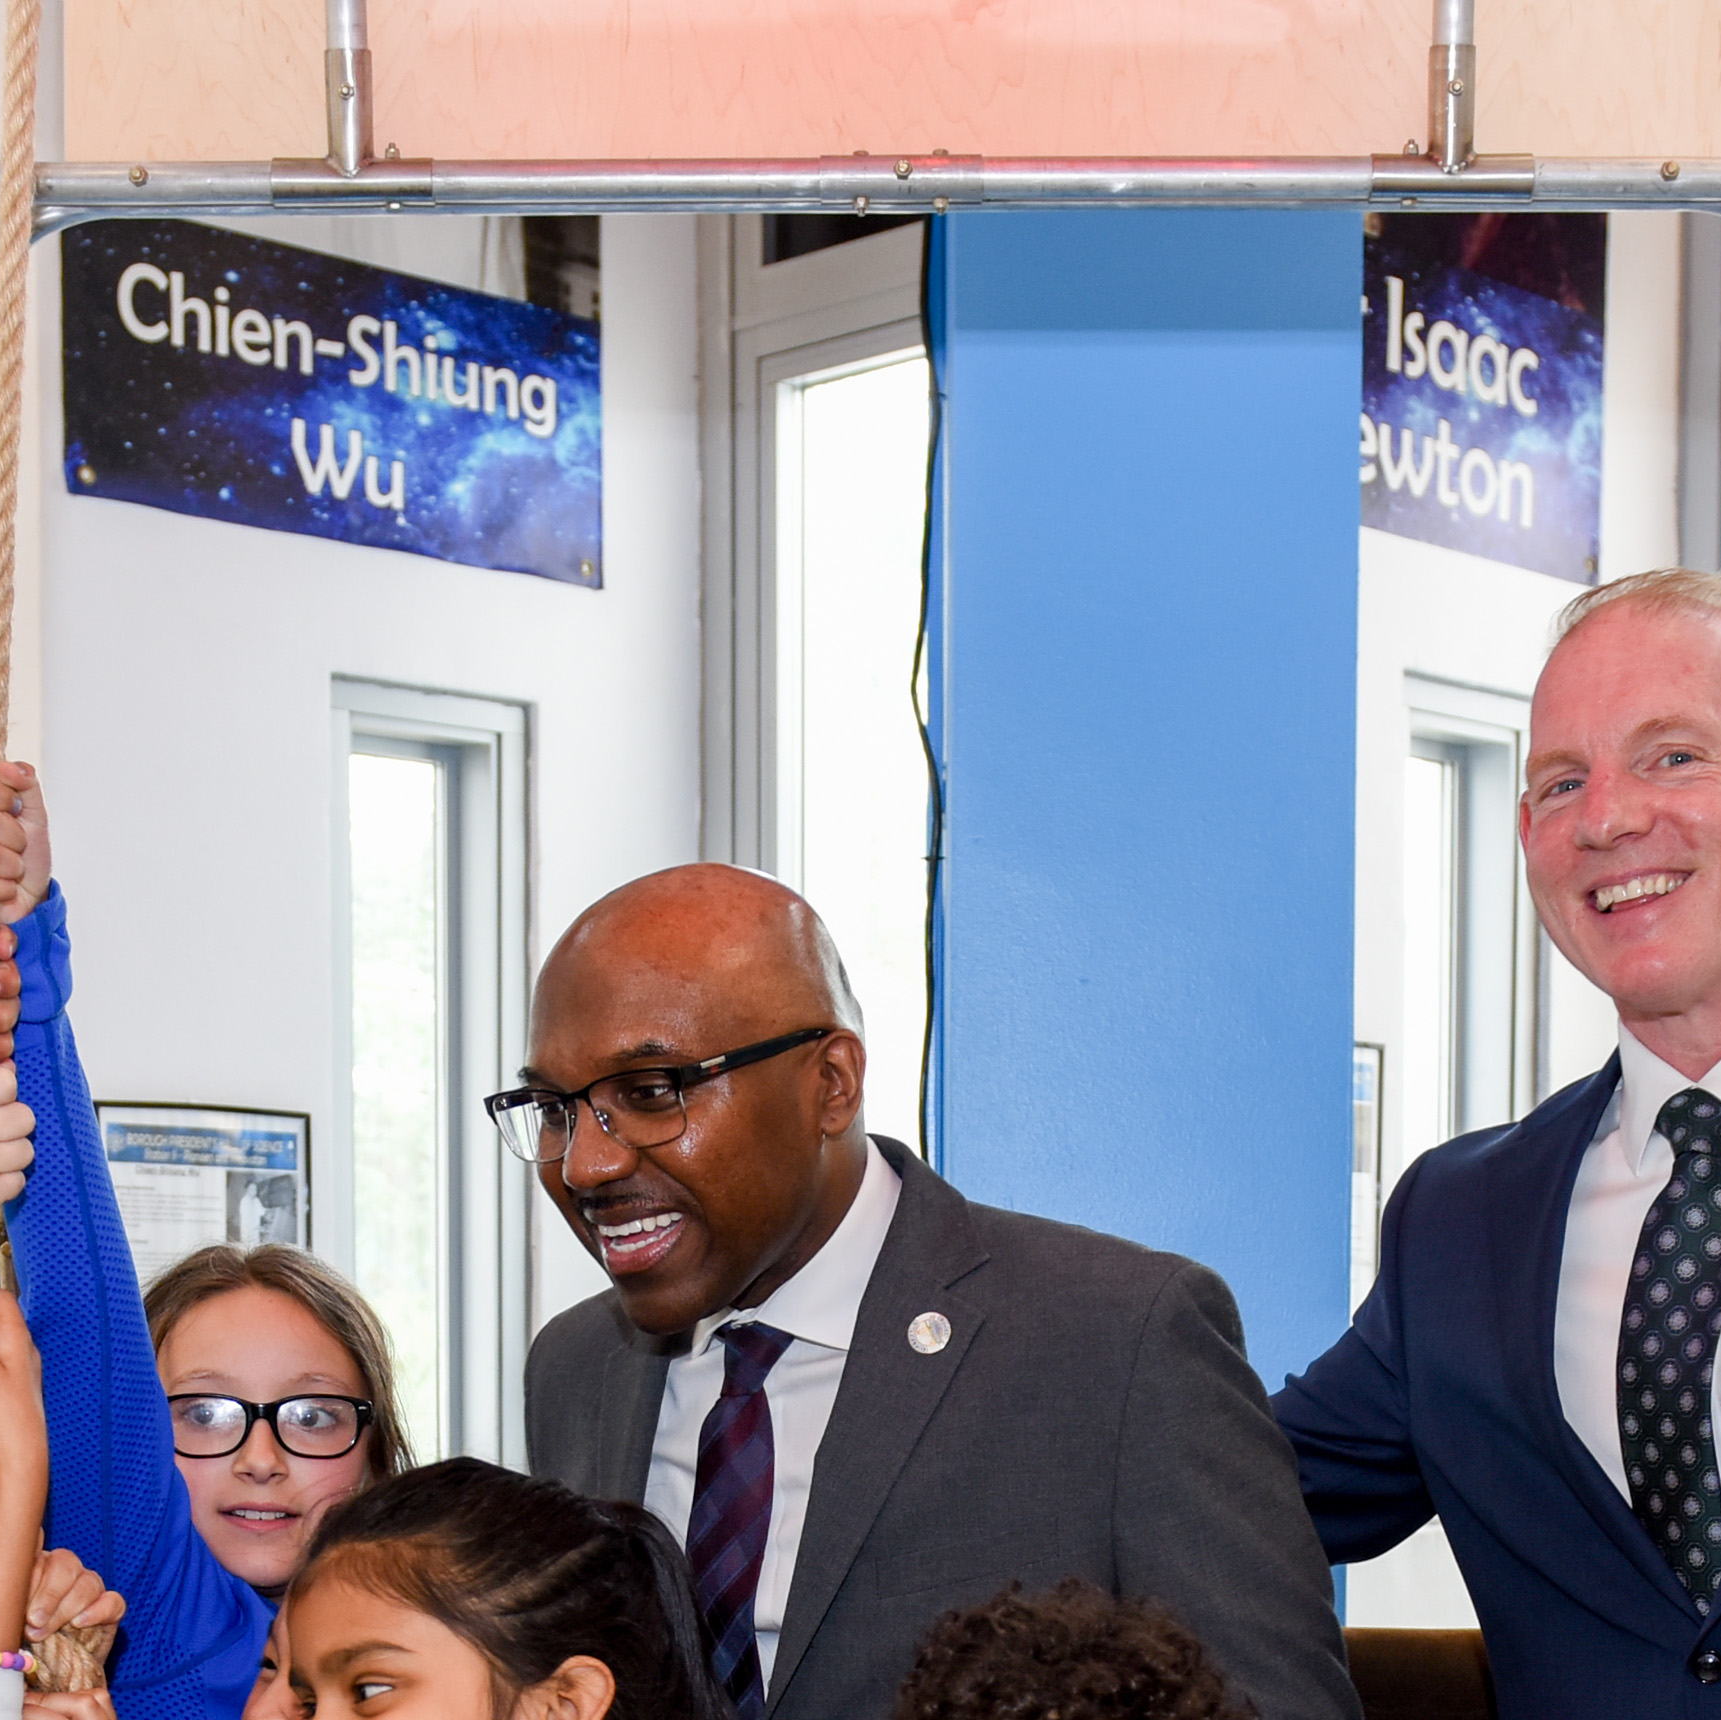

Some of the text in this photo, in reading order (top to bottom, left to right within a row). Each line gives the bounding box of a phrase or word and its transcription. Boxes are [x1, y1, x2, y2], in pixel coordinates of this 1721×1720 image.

[116, 262, 558, 438] Chien-Shiung
[1385, 276, 1540, 417] Isaac
[291, 418, 405, 510] Wu
[1360, 411, 1533, 530] ewton
